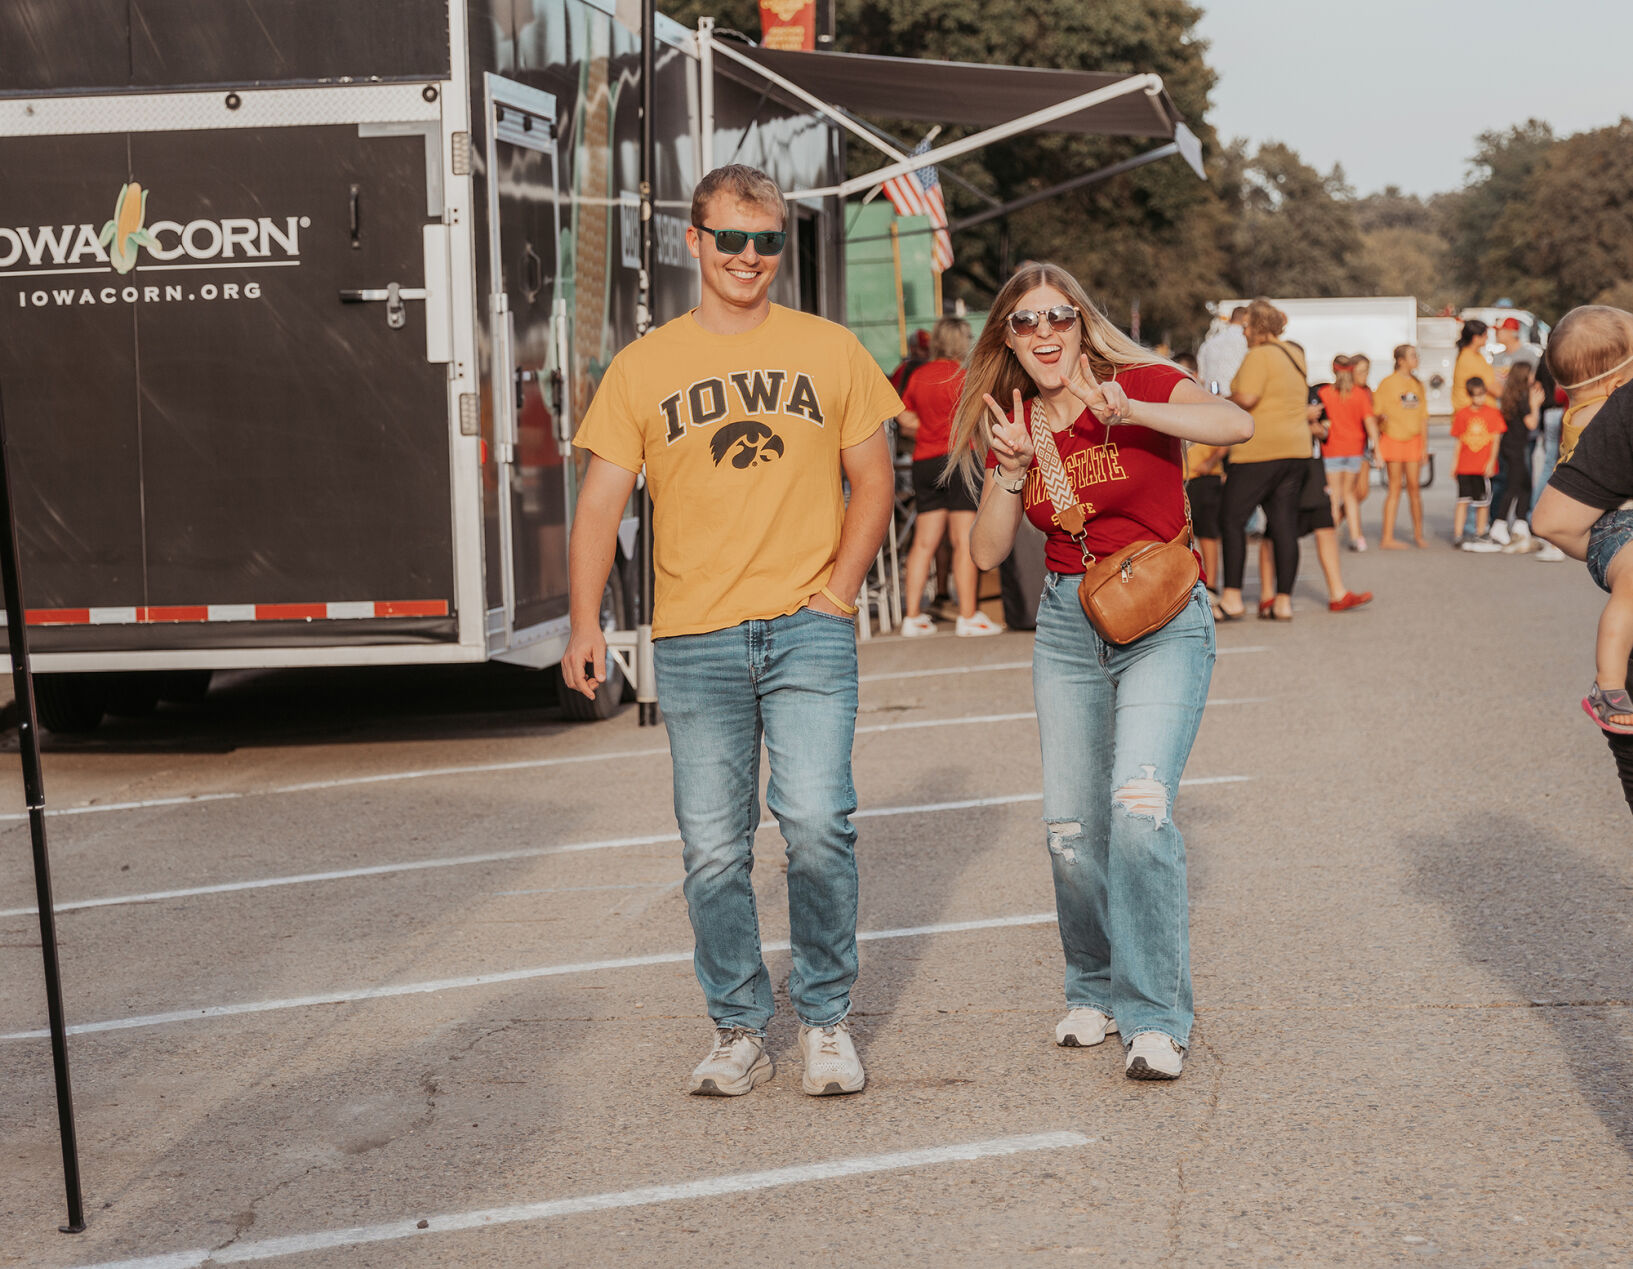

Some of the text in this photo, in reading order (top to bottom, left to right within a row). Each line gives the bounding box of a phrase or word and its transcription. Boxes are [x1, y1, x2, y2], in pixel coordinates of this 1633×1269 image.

[19, 282, 262, 307] IOWACORN.ORG
[658, 369, 825, 447] IOWA
[1064, 442, 1126, 493] STATE
